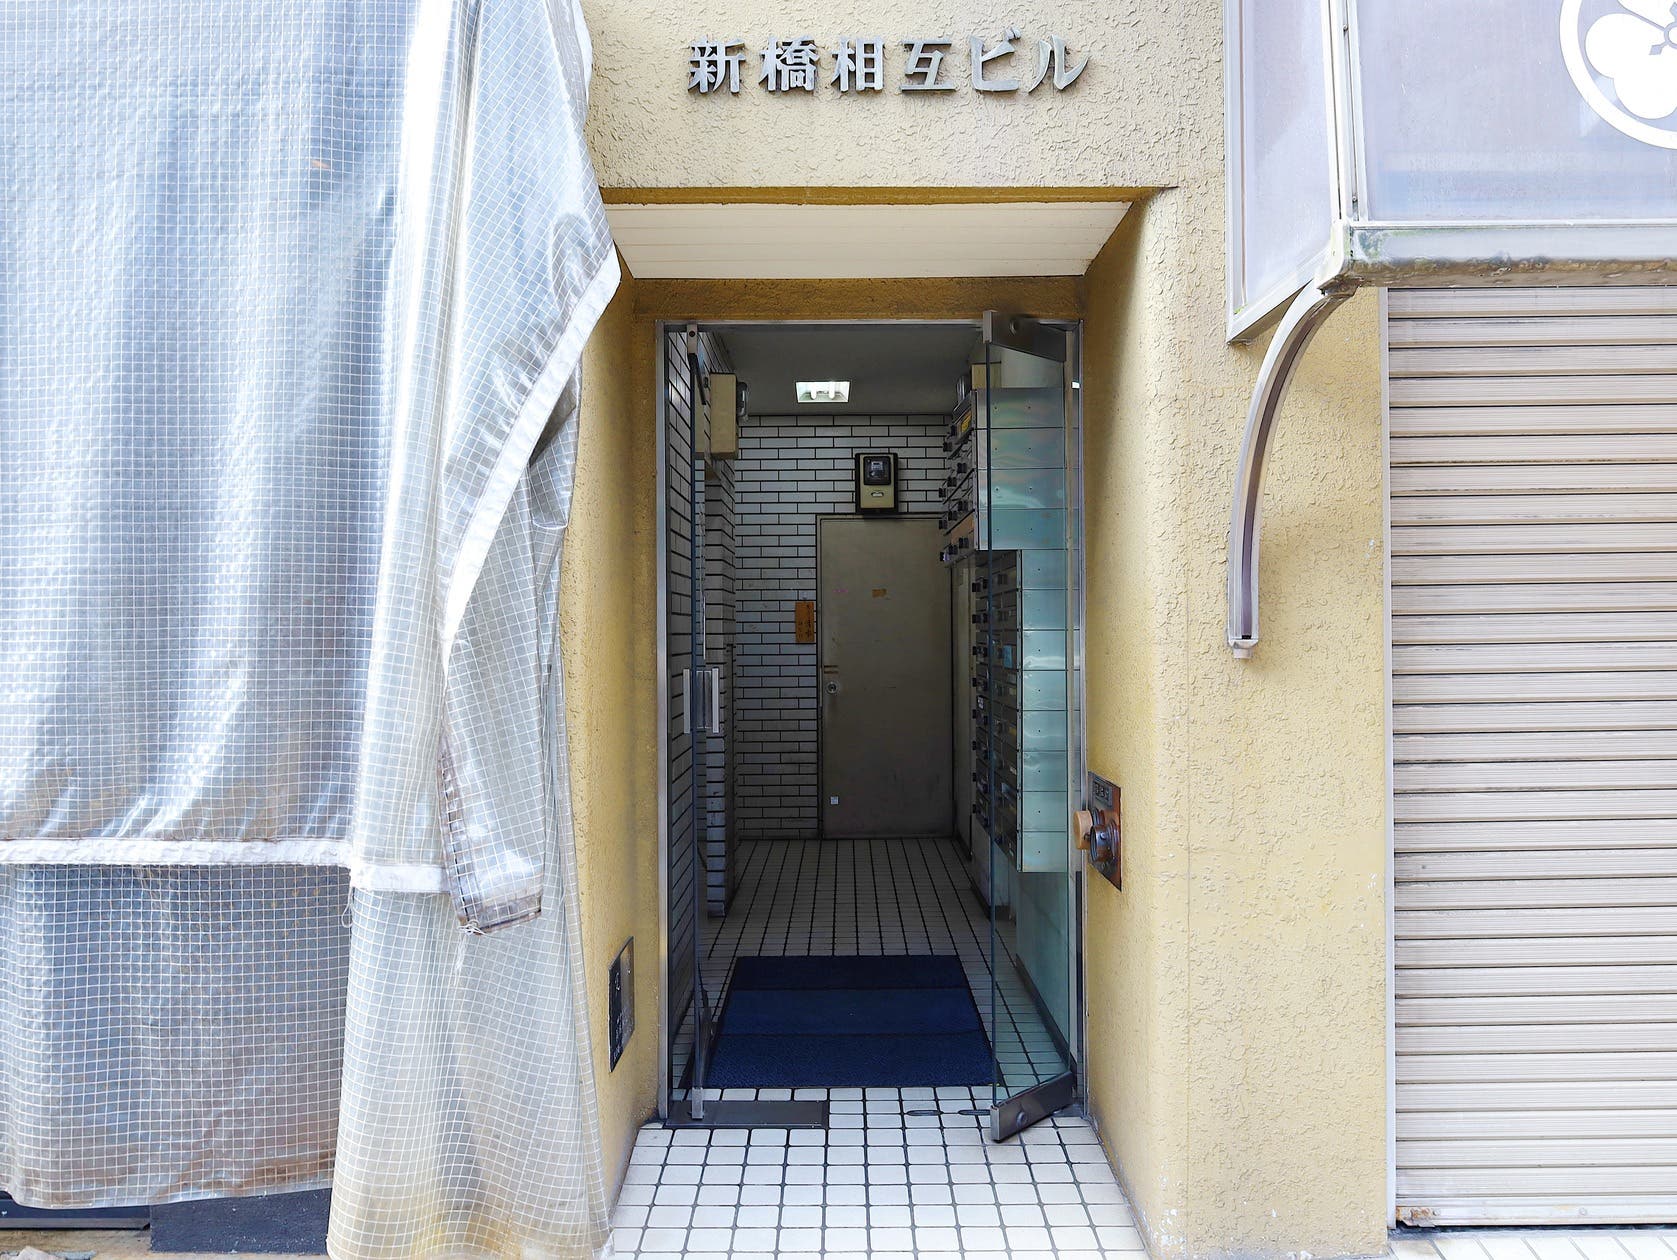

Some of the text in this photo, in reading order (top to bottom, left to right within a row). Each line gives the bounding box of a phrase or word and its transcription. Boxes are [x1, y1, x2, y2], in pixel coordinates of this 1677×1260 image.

[688, 28, 1089, 94] 新橋相互ビル
